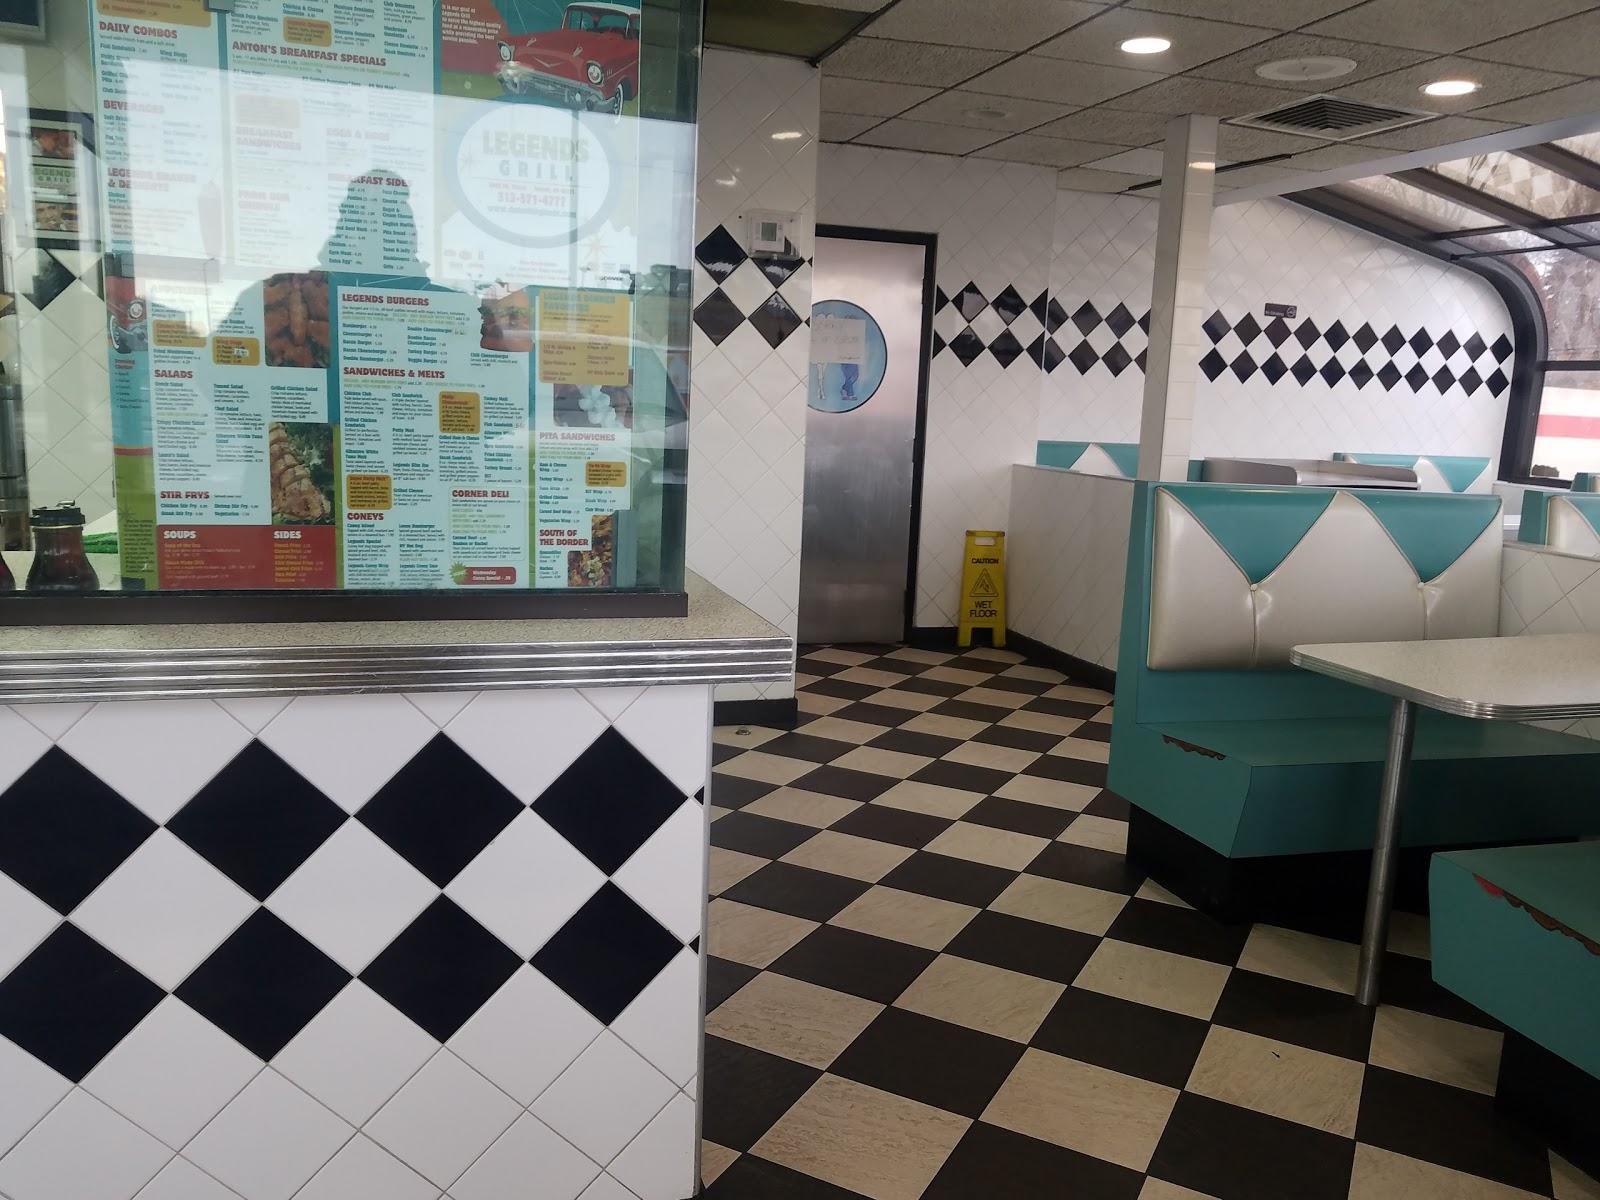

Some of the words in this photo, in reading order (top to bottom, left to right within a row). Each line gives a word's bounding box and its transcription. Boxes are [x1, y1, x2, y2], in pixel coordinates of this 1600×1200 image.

[99, 22, 130, 33] DAILY
[133, 26, 178, 39] COMBOS
[232, 41, 277, 55] ANTON'S
[280, 47, 338, 62] BREAKFAST
[340, 53, 386, 67] SPECIALS
[482, 130, 591, 162] LEGENDS
[342, 294, 384, 304] LEGENDS
[387, 297, 429, 306] BURGERS
[154, 370, 193, 379] SALADS
[344, 367, 406, 377] SANDWICHES
[408, 369, 415, 378] &
[418, 370, 445, 378] MELTS
[540, 432, 558, 440] PITA
[560, 433, 615, 441] SANDWICHES
[160, 491, 182, 499] STIR
[185, 491, 210, 499] FRYS
[452, 490, 488, 498] CORNER
[491, 490, 509, 498] DELI
[347, 512, 384, 520] CONEYS
[163, 531, 197, 539] SOUPS
[273, 531, 302, 539] SIDES
[540, 529, 565, 537] SOUTH
[975, 601, 992, 609] WET
[970, 609, 997, 617] FLOOR
